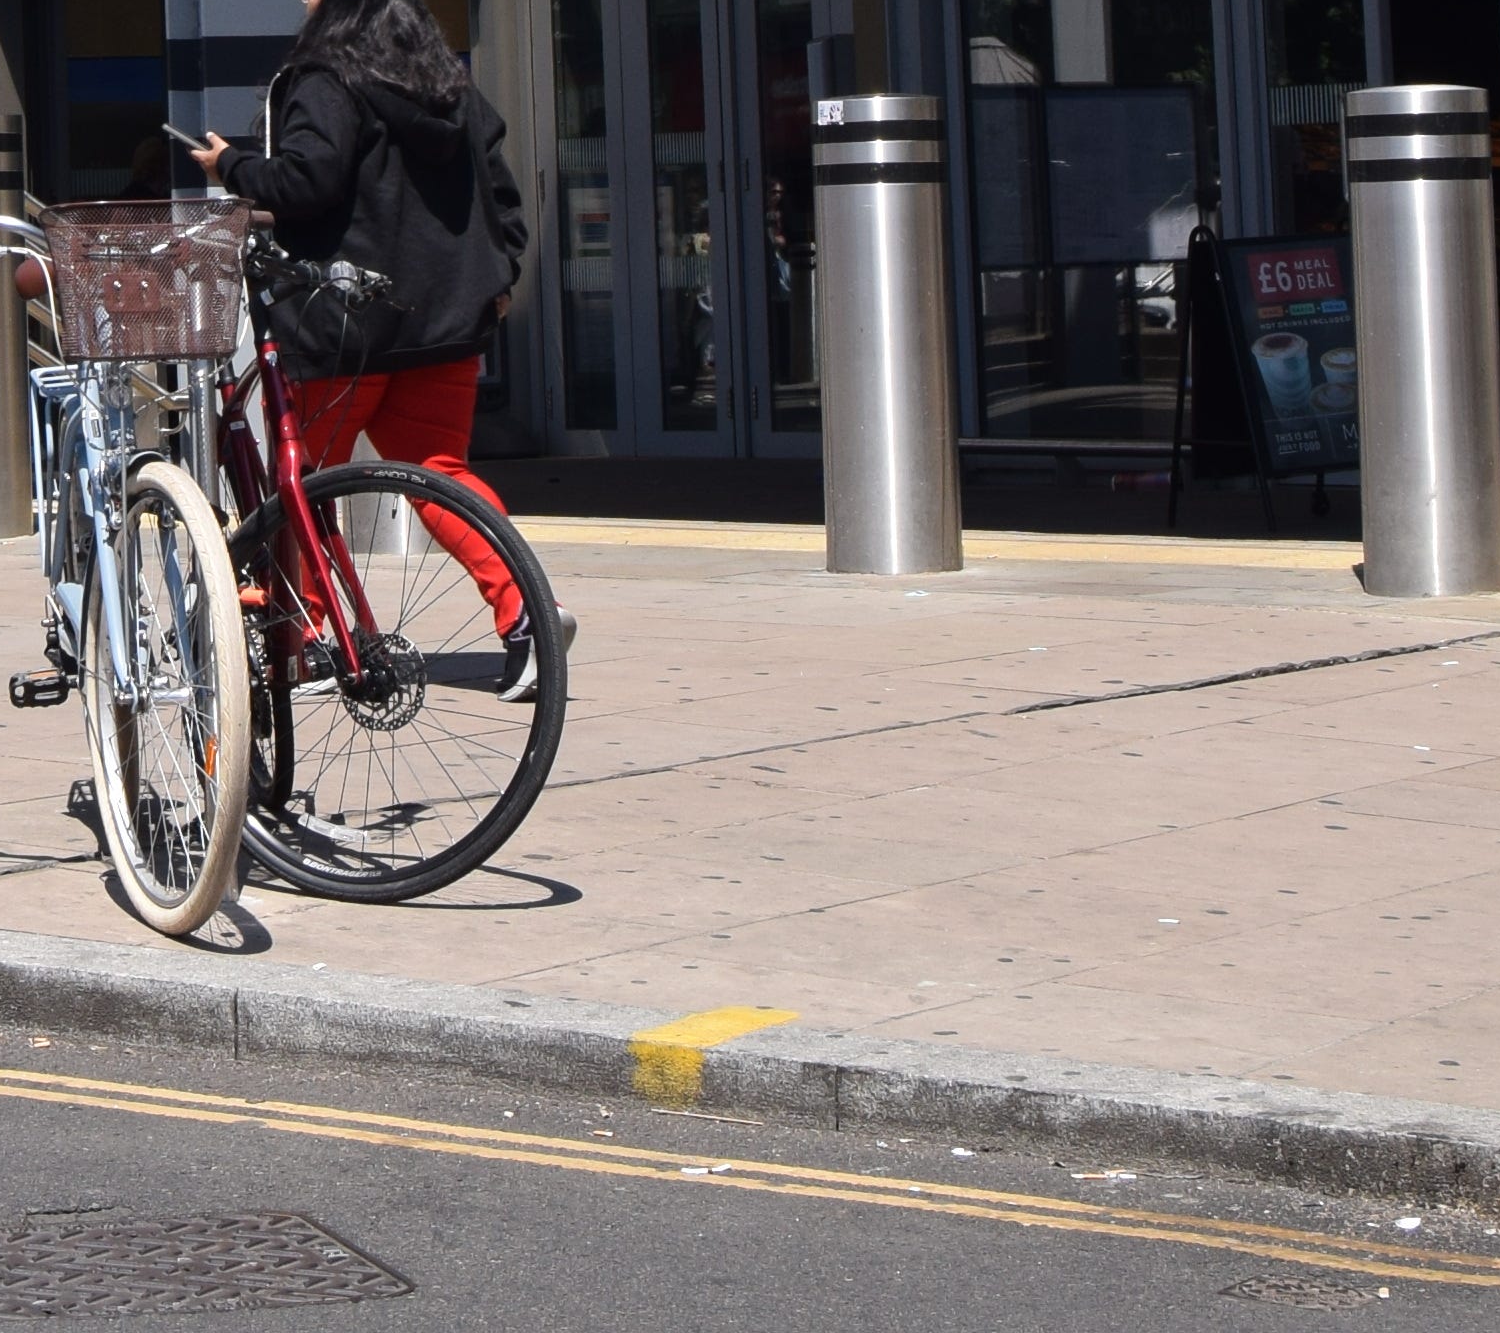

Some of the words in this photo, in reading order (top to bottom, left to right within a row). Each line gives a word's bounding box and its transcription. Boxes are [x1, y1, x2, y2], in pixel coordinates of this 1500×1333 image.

[1258, 260, 1293, 294] £6
[1294, 259, 1331, 271] MEAL
[1296, 272, 1335, 291] DEAL
